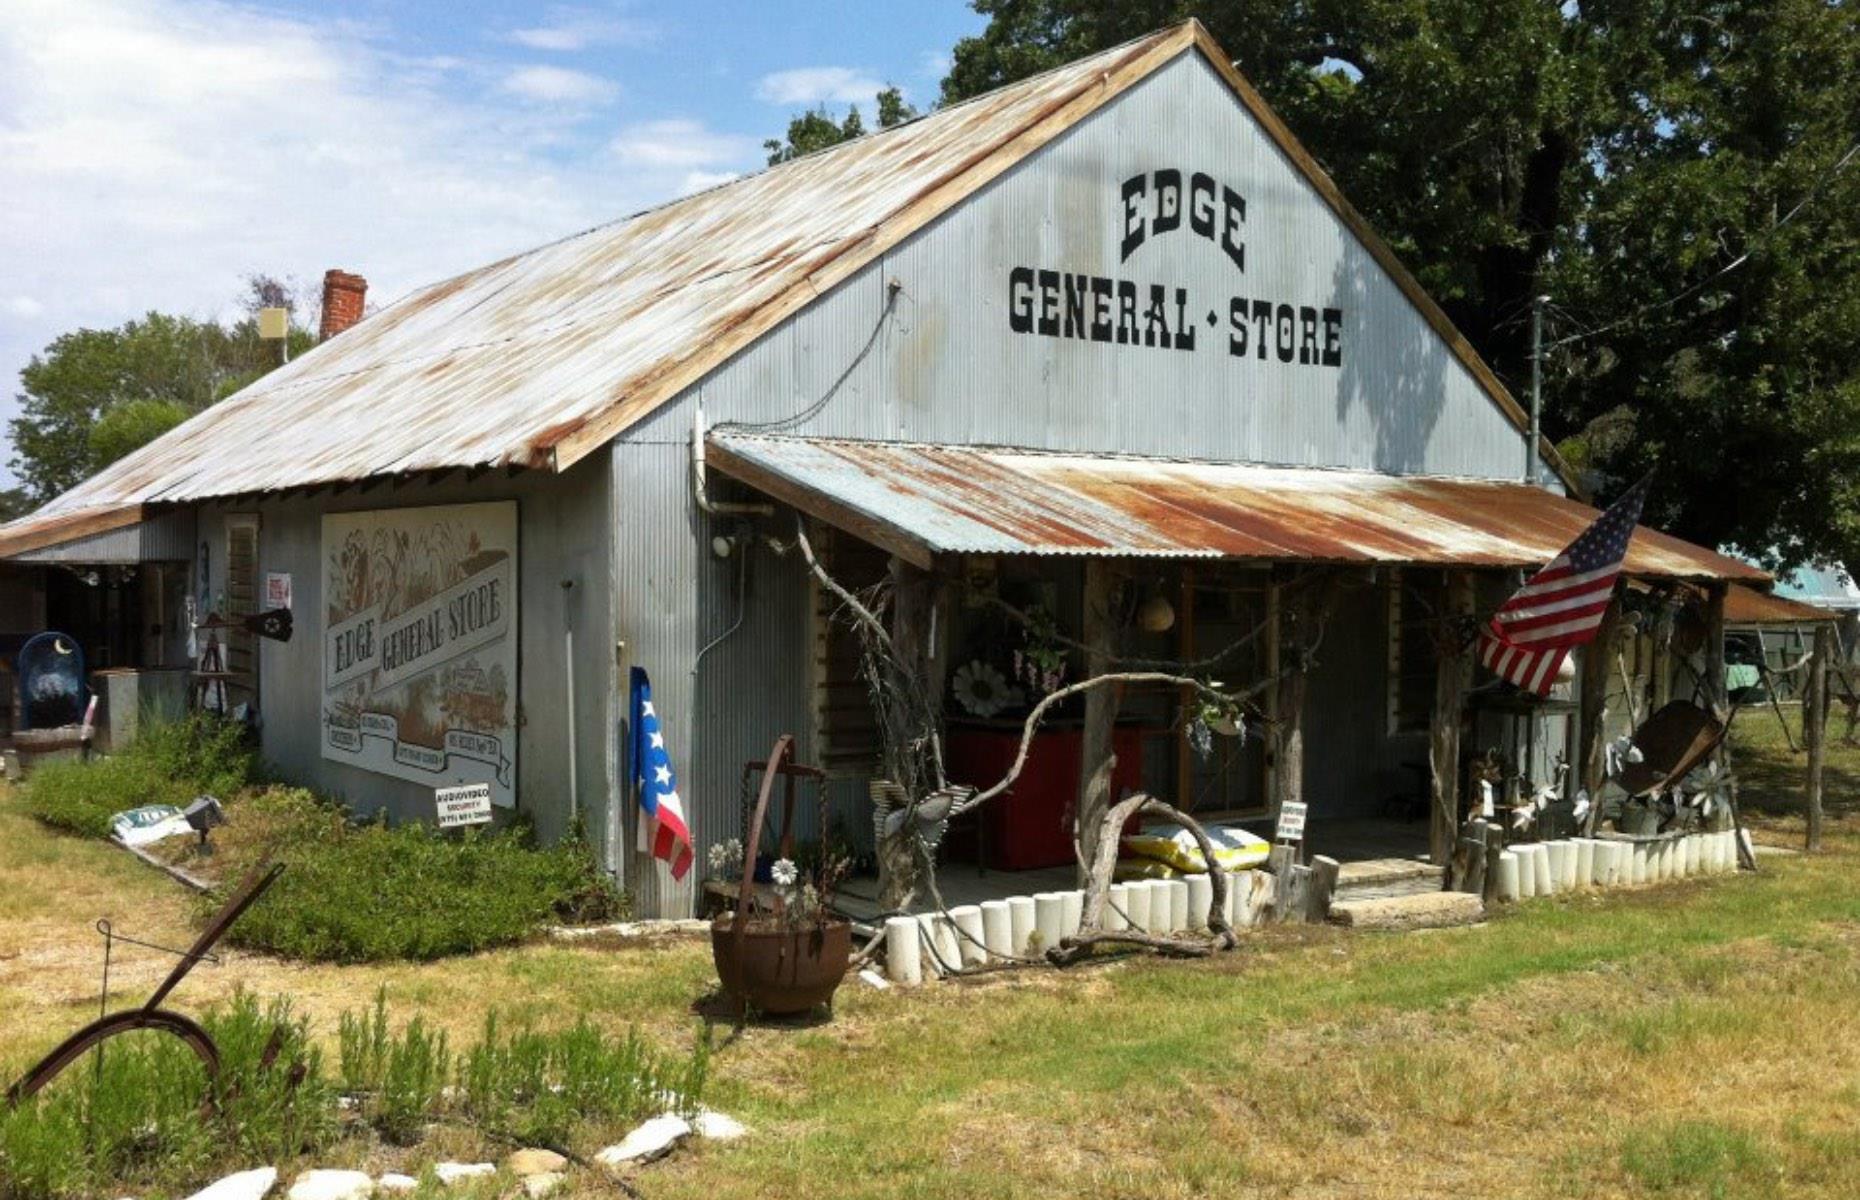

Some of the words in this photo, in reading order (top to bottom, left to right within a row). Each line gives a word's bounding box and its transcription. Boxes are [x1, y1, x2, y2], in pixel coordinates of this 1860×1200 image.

[1121, 168, 1246, 274] EDGE
[1009, 266, 1195, 351] GENERAL
[1230, 296, 1342, 367] STORE
[335, 618, 374, 673] EDGE
[383, 608, 445, 671] GENERAL
[449, 578, 501, 641] STORE
